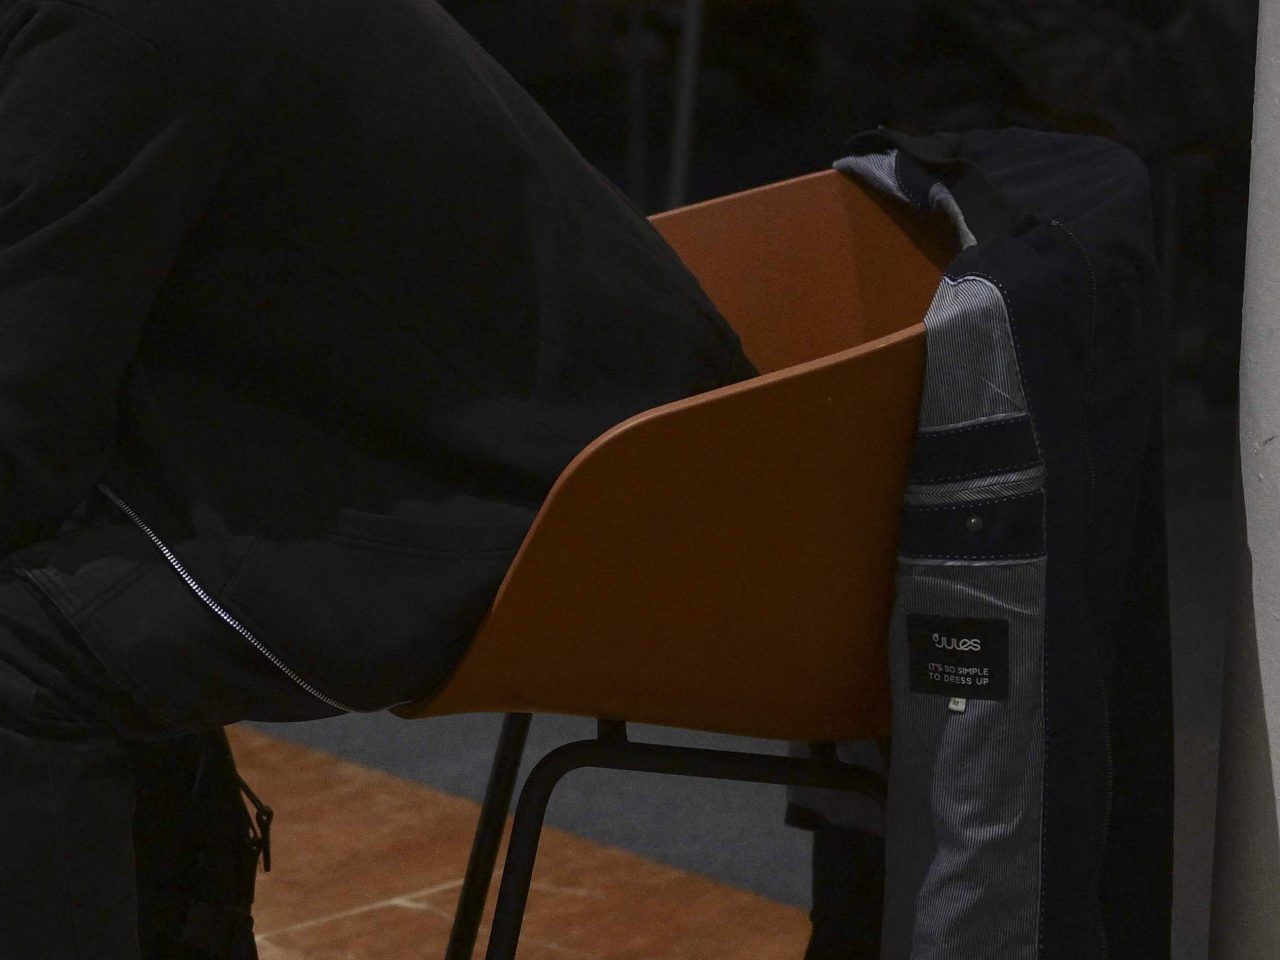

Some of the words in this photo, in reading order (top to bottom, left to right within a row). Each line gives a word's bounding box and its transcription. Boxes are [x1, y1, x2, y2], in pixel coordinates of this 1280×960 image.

[928, 662, 943, 671] IT'S
[944, 665, 956, 673] SO
[957, 667, 989, 676] SIMPLE
[928, 672, 940, 680] TO
[944, 675, 972, 685] DRESS
